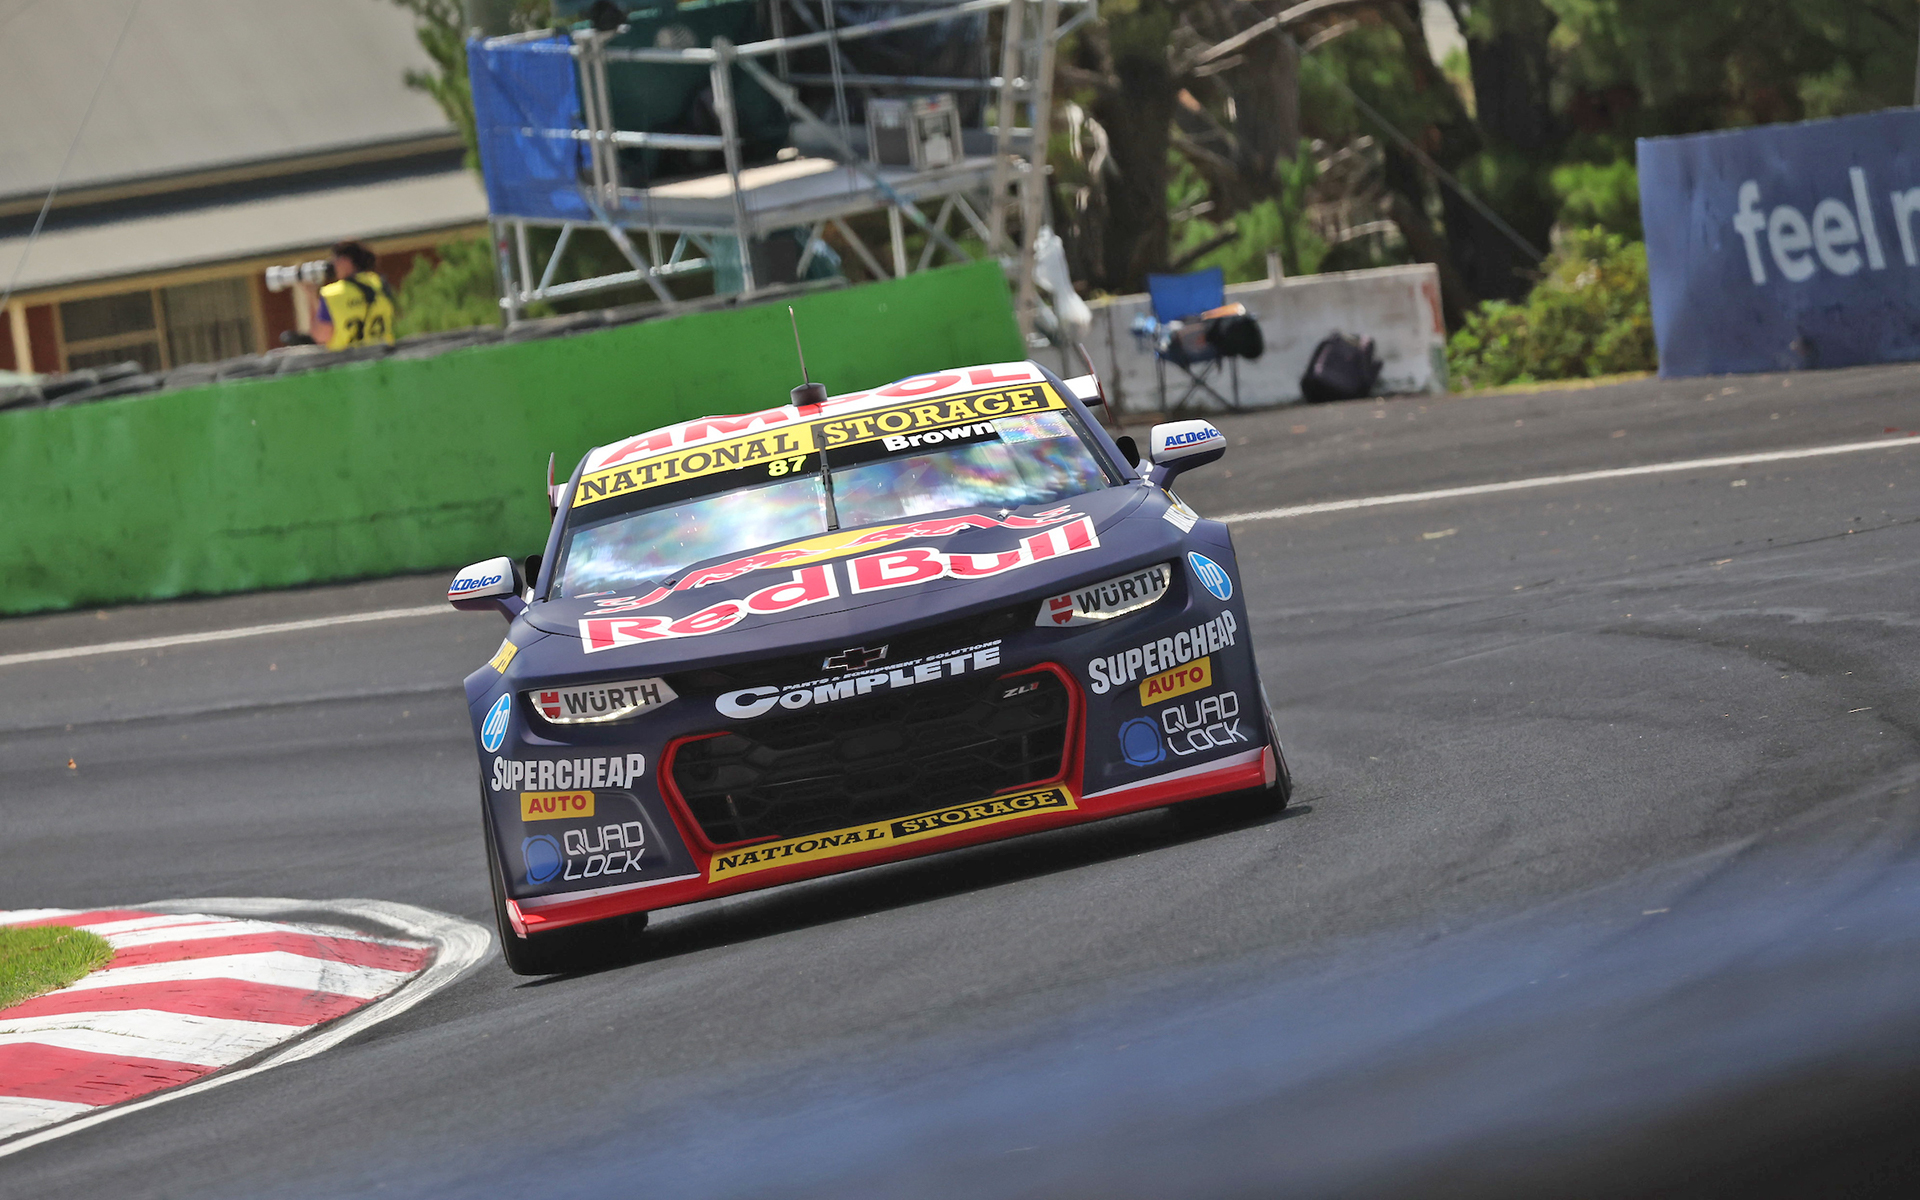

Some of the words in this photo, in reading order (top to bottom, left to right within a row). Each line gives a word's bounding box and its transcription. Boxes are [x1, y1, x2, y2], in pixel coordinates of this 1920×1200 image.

[1732, 166, 1887, 286] feel
[598, 368, 1031, 467] AMPOL
[881, 420, 996, 452] Brown
[580, 432, 799, 502] NATIONAL
[823, 388, 1040, 445] STORAGE
[768, 454, 807, 477] 87
[581, 564, 834, 652] Red
[848, 517, 1098, 593] Bull
[1076, 567, 1167, 615] WÜRTH
[1194, 555, 1228, 600] hp
[843, 658, 922, 679] EQUIPMENT
[925, 639, 1002, 662] SOLUTIONS
[1088, 609, 1238, 695] SUPERCHEAP
[564, 683, 662, 715] WÜRTH
[1003, 682, 1040, 699] ZL1
[1147, 666, 1204, 698] AUTO
[483, 696, 509, 750] hp
[1161, 691, 1239, 734] QUAD
[1167, 718, 1248, 756] LOCK
[491, 753, 646, 792] SUPERCHEAP
[528, 795, 587, 814] AUTO
[563, 821, 645, 855] QUAD
[715, 828, 885, 872] NATIONAL
[901, 791, 1058, 833] STORAGE
[563, 848, 646, 881] LOCK
